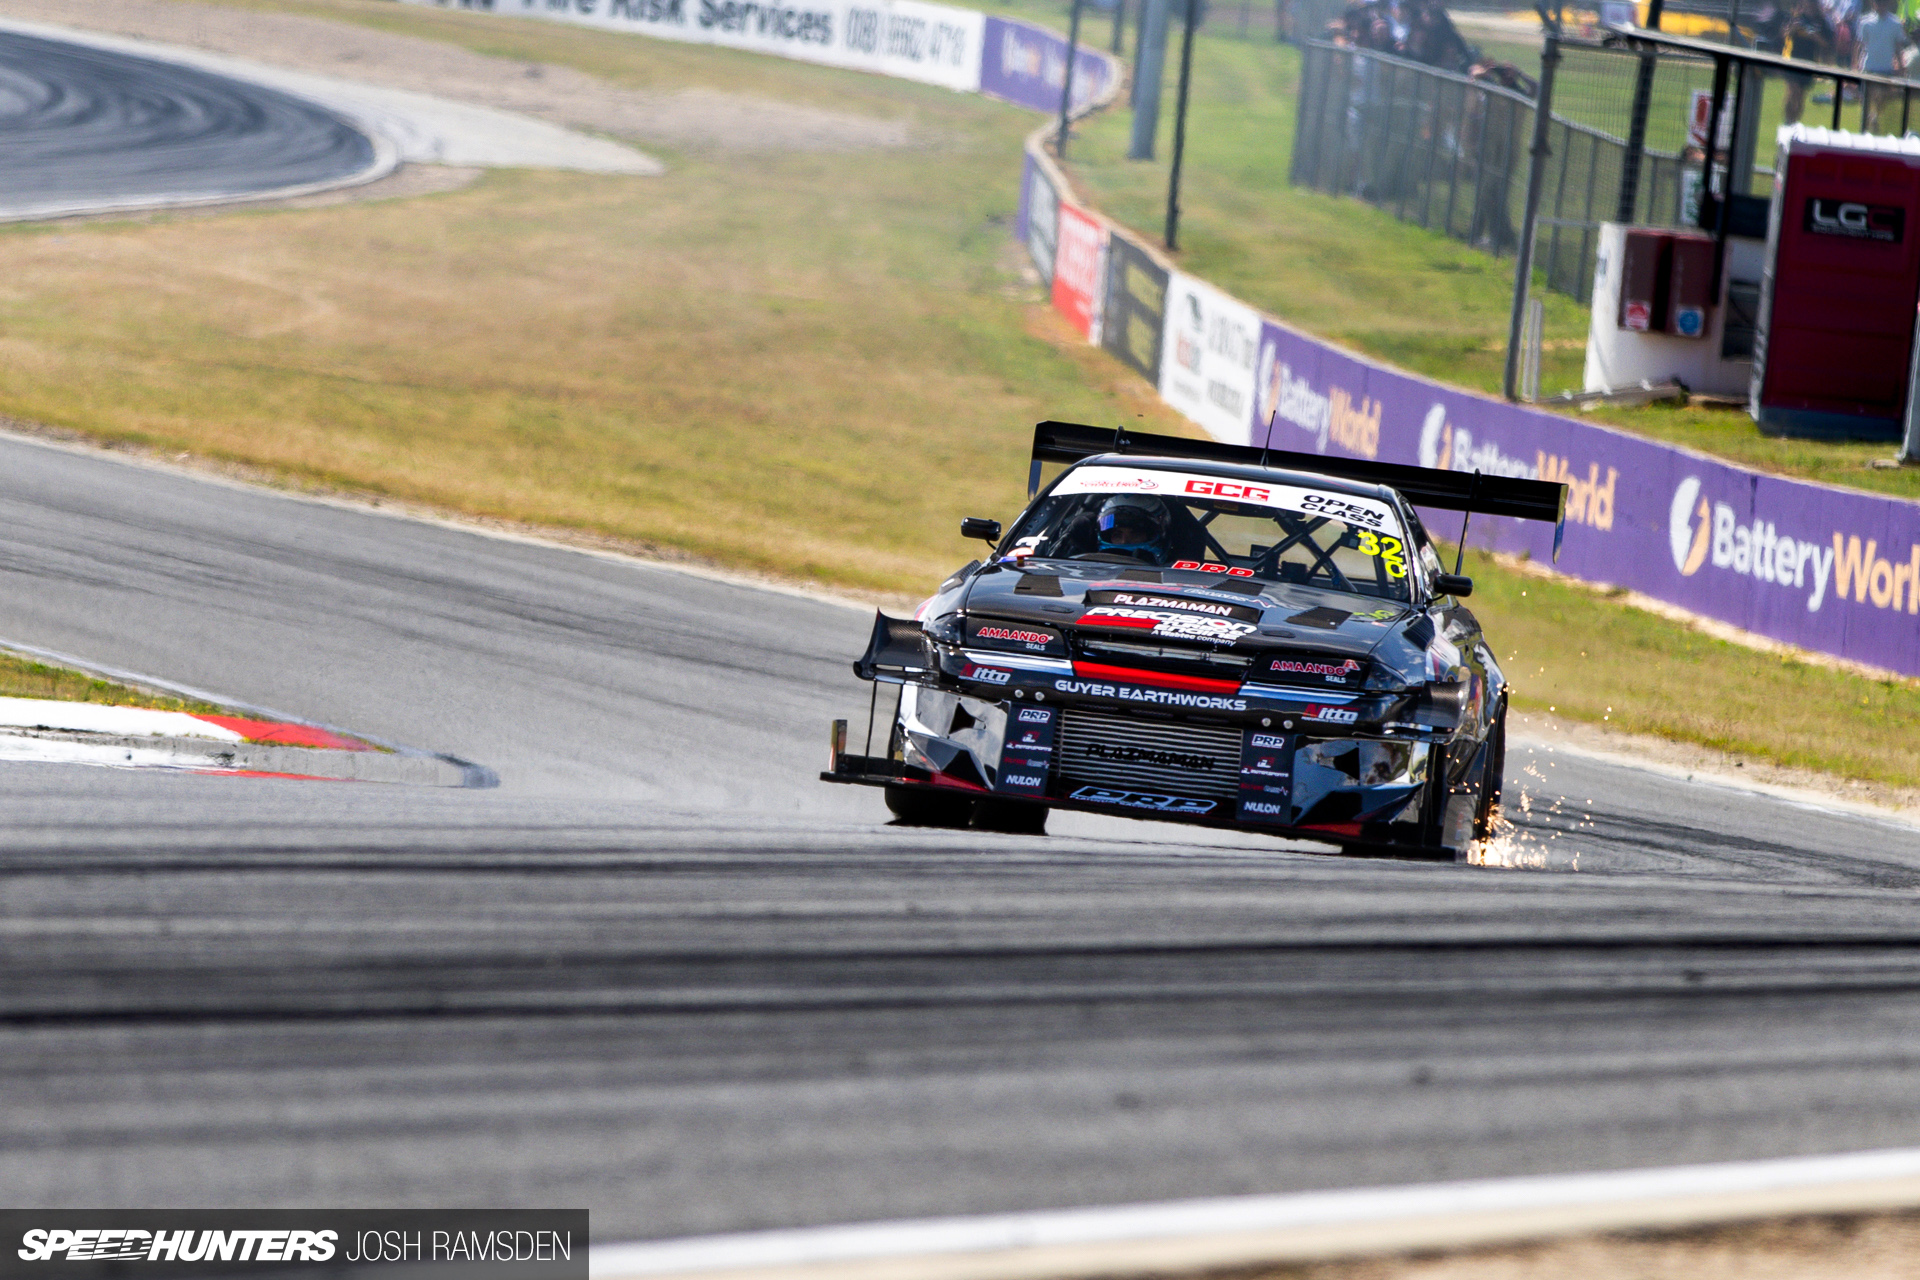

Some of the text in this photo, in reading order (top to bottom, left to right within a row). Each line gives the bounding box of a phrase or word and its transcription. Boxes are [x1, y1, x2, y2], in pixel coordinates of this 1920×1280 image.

[697, 0, 832, 45] Services
[1184, 480, 1271, 502] GCG
[1300, 502, 1383, 527] CLASS
[1303, 494, 1385, 520] OPEN
[1712, 502, 1920, 615] BatteryWorl
[1113, 593, 1233, 617] PLAZMAMAN
[976, 626, 1050, 645] AMAANDO
[1195, 634, 1238, 647] company
[1025, 642, 1046, 651] SEALS
[1269, 660, 1347, 677] AMAANDO
[1325, 675, 1346, 684] SEALS
[1054, 679, 1248, 711] GUYER EARTHWORKS
[1020, 710, 1050, 720] PRP
[1253, 735, 1283, 746] PRP
[1005, 774, 1042, 787] NULON
[1070, 785, 1218, 814] PRP
[1243, 801, 1281, 814] NULON
